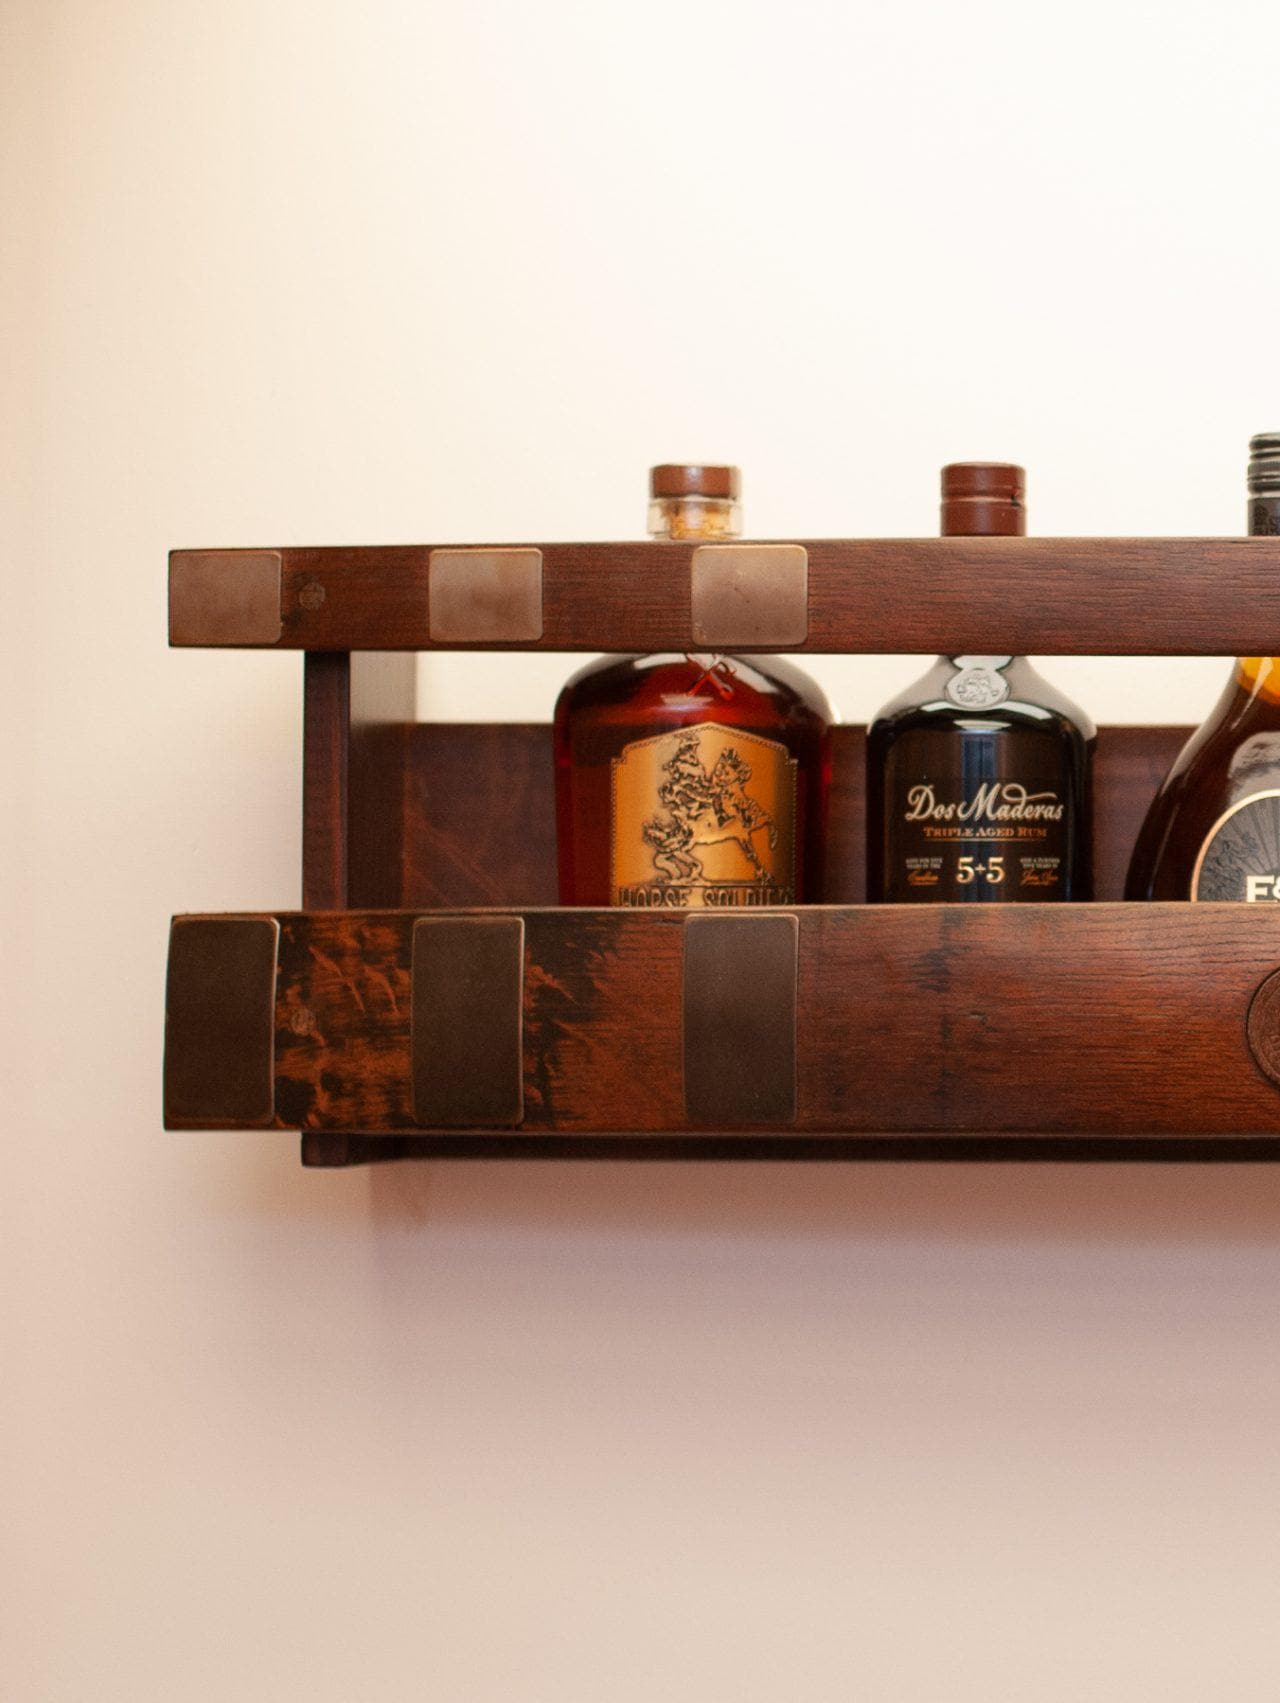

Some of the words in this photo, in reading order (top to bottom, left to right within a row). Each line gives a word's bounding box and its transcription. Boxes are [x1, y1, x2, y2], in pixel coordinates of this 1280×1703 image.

[905, 785, 955, 822] Dos
[957, 781, 1064, 822] Maderas
[923, 827, 973, 837] TRIPLE
[976, 827, 1014, 837] AGED
[1017, 827, 1048, 837] RUM
[956, 857, 1006, 884] 5+5
